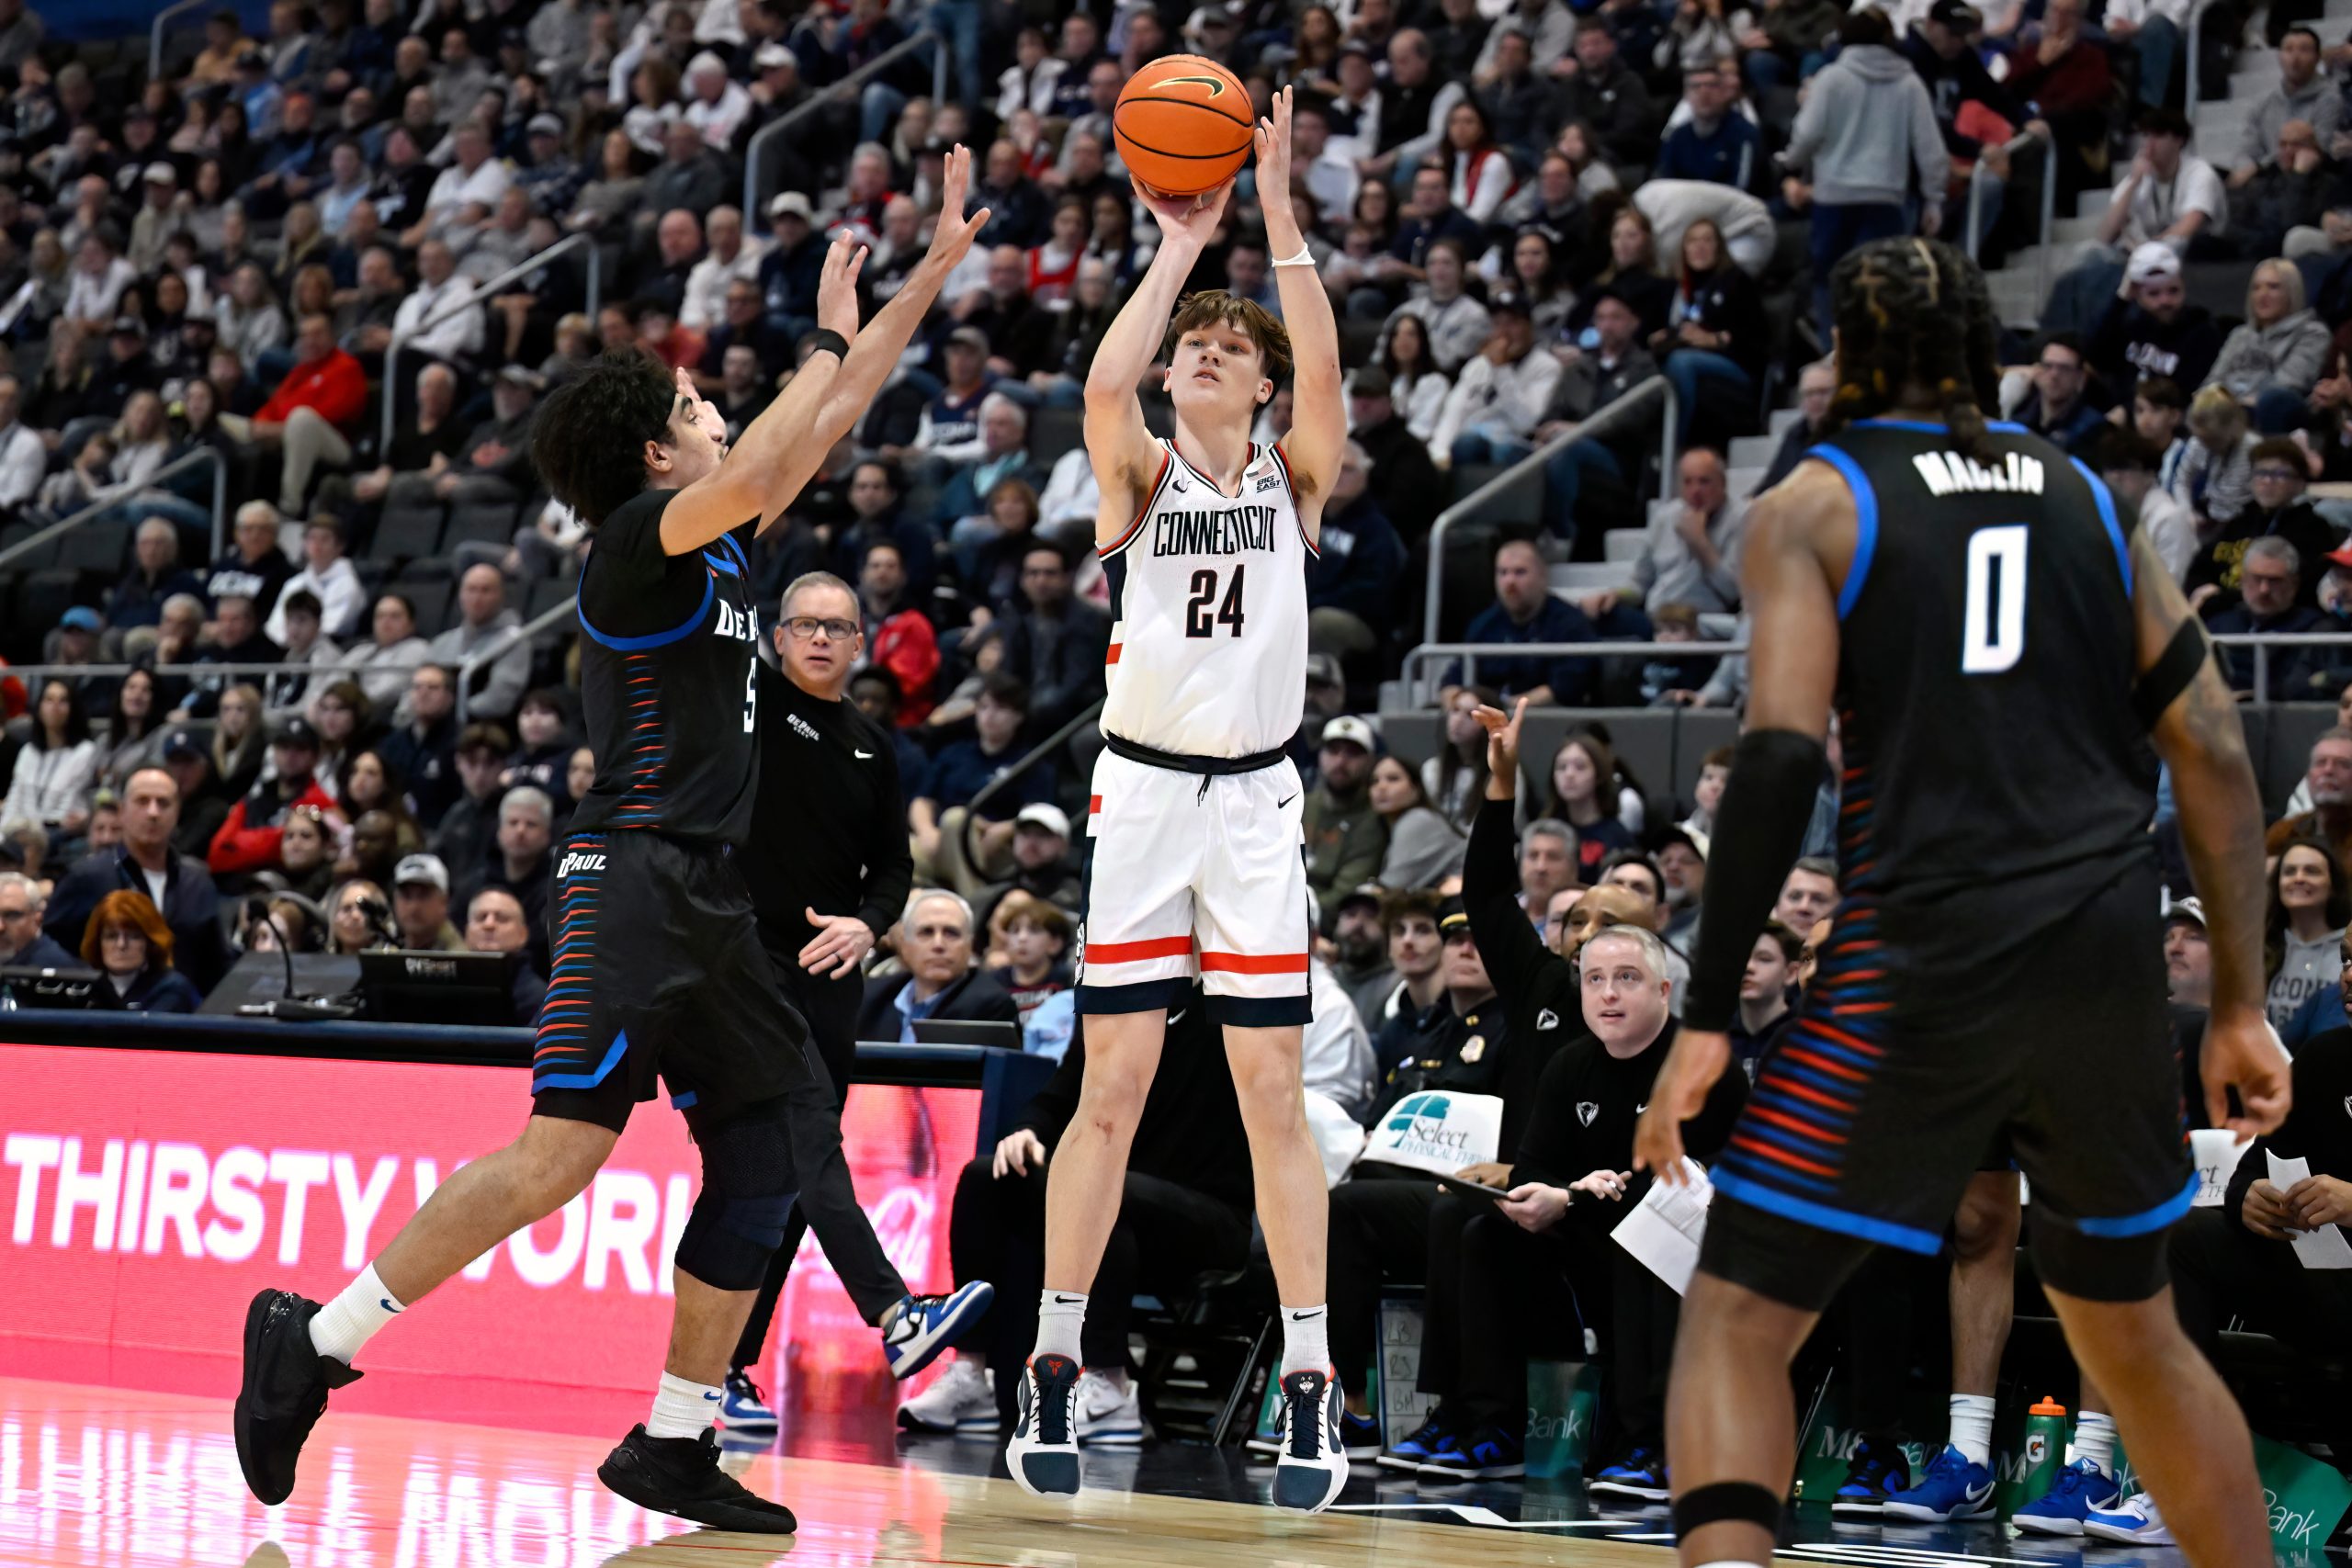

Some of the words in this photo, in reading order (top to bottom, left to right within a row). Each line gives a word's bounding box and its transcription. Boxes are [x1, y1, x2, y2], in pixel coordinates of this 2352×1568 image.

[1256, 475, 1274, 486] BIG
[1256, 479, 1281, 491] EAST
[1153, 505, 1277, 558] CONNECTICUT
[1185, 564, 1245, 638] 24
[1961, 524, 2029, 674] 0
[743, 657, 757, 733] 5
[1408, 1114, 1470, 1149] Select
[5, 1133, 401, 1270] THIRSTY
[1525, 1407, 1584, 1440] Bank
